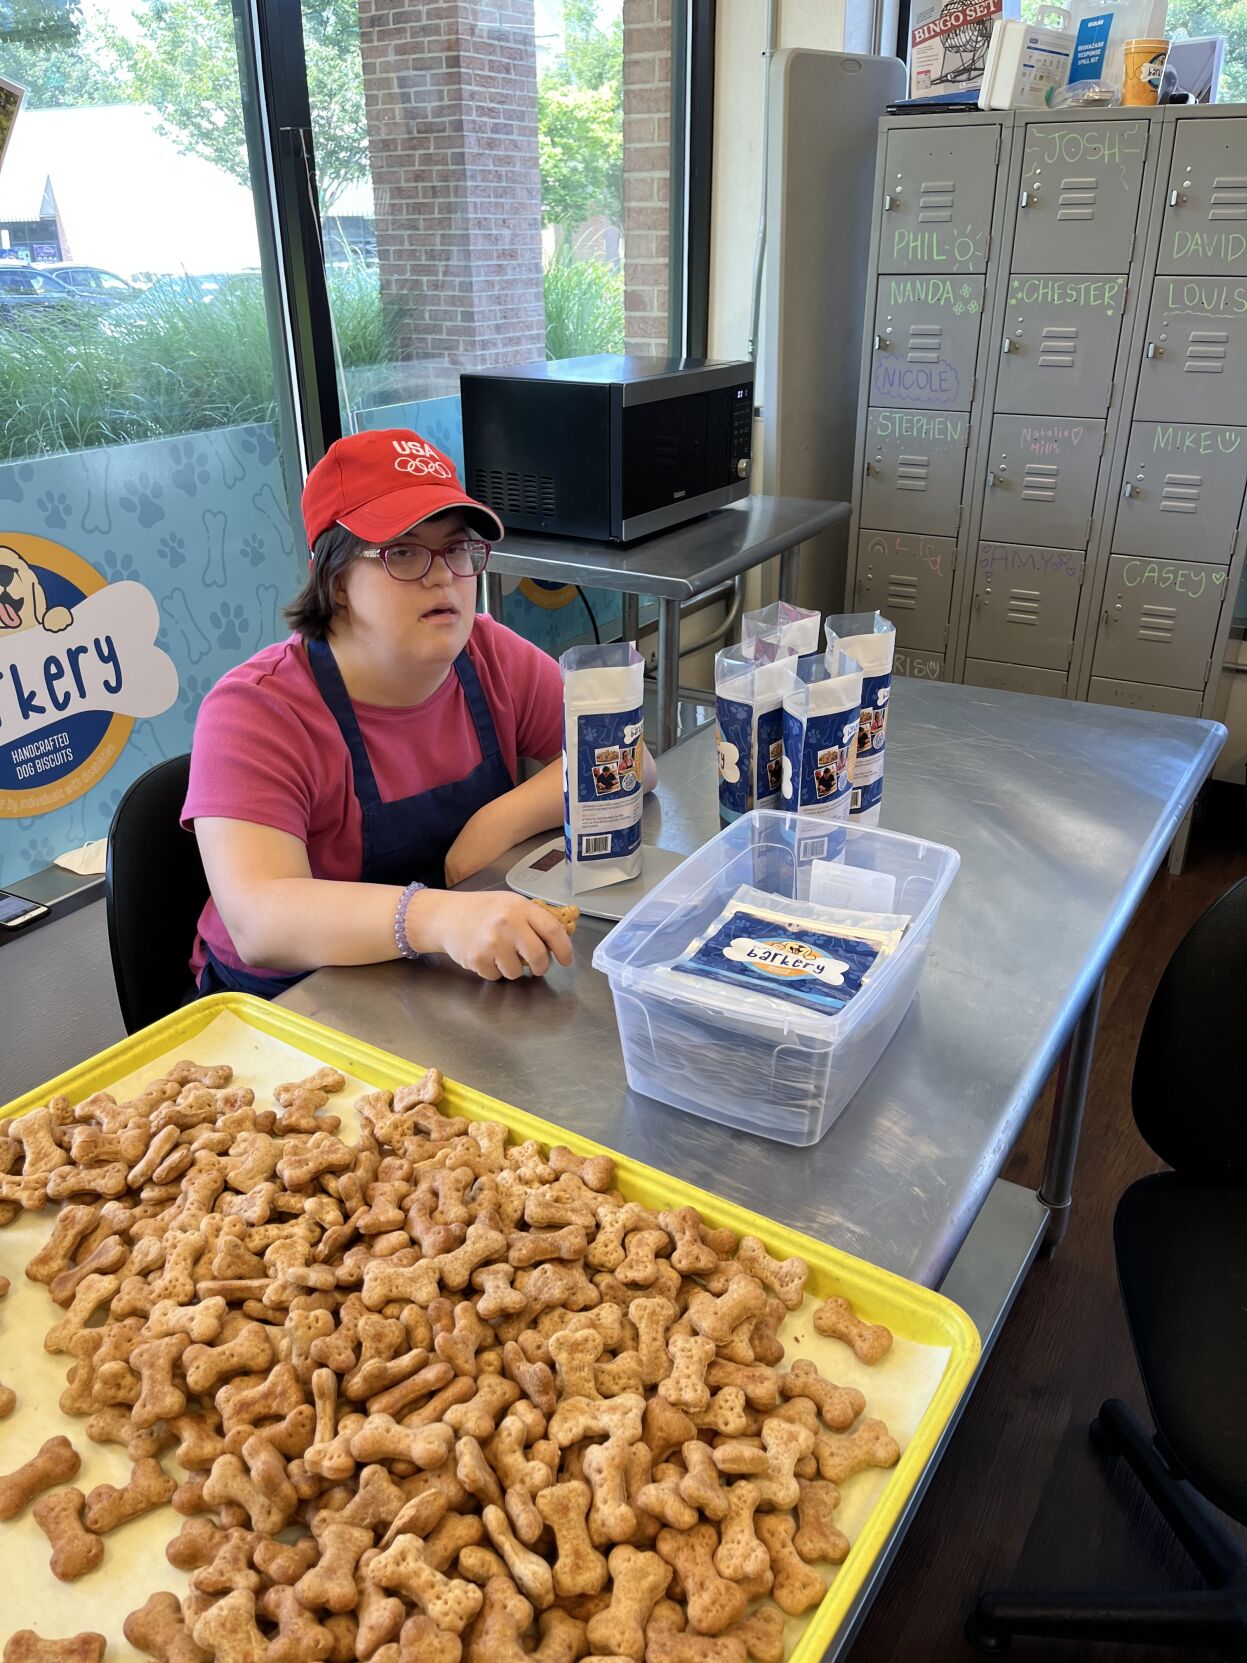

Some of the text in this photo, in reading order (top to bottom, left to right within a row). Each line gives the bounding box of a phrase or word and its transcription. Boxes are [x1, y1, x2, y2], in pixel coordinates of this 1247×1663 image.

[914, 11, 964, 43] BINGO
[965, 0, 997, 21] SET
[1044, 131, 1121, 164] JOSH
[893, 229, 946, 261] PHIL
[1173, 230, 1246, 262] DAVID
[890, 280, 954, 306] NANDA
[1023, 279, 1118, 307] CHESTER
[1168, 283, 1247, 312] LOUIS
[882, 367, 951, 394] NICOLE
[877, 412, 962, 441] STEPHEN
[1153, 426, 1212, 455] MIKE
[392, 440, 440, 460] USA
[990, 545, 1054, 575] AMY
[1122, 561, 1206, 598] CASEY
[893, 653, 927, 677] RIS
[0, 635, 123, 727] kery
[11, 732, 70, 764] HANDCRAFTED
[16, 748, 74, 780] DOG BISCUITS
[746, 948, 826, 975] barkery
